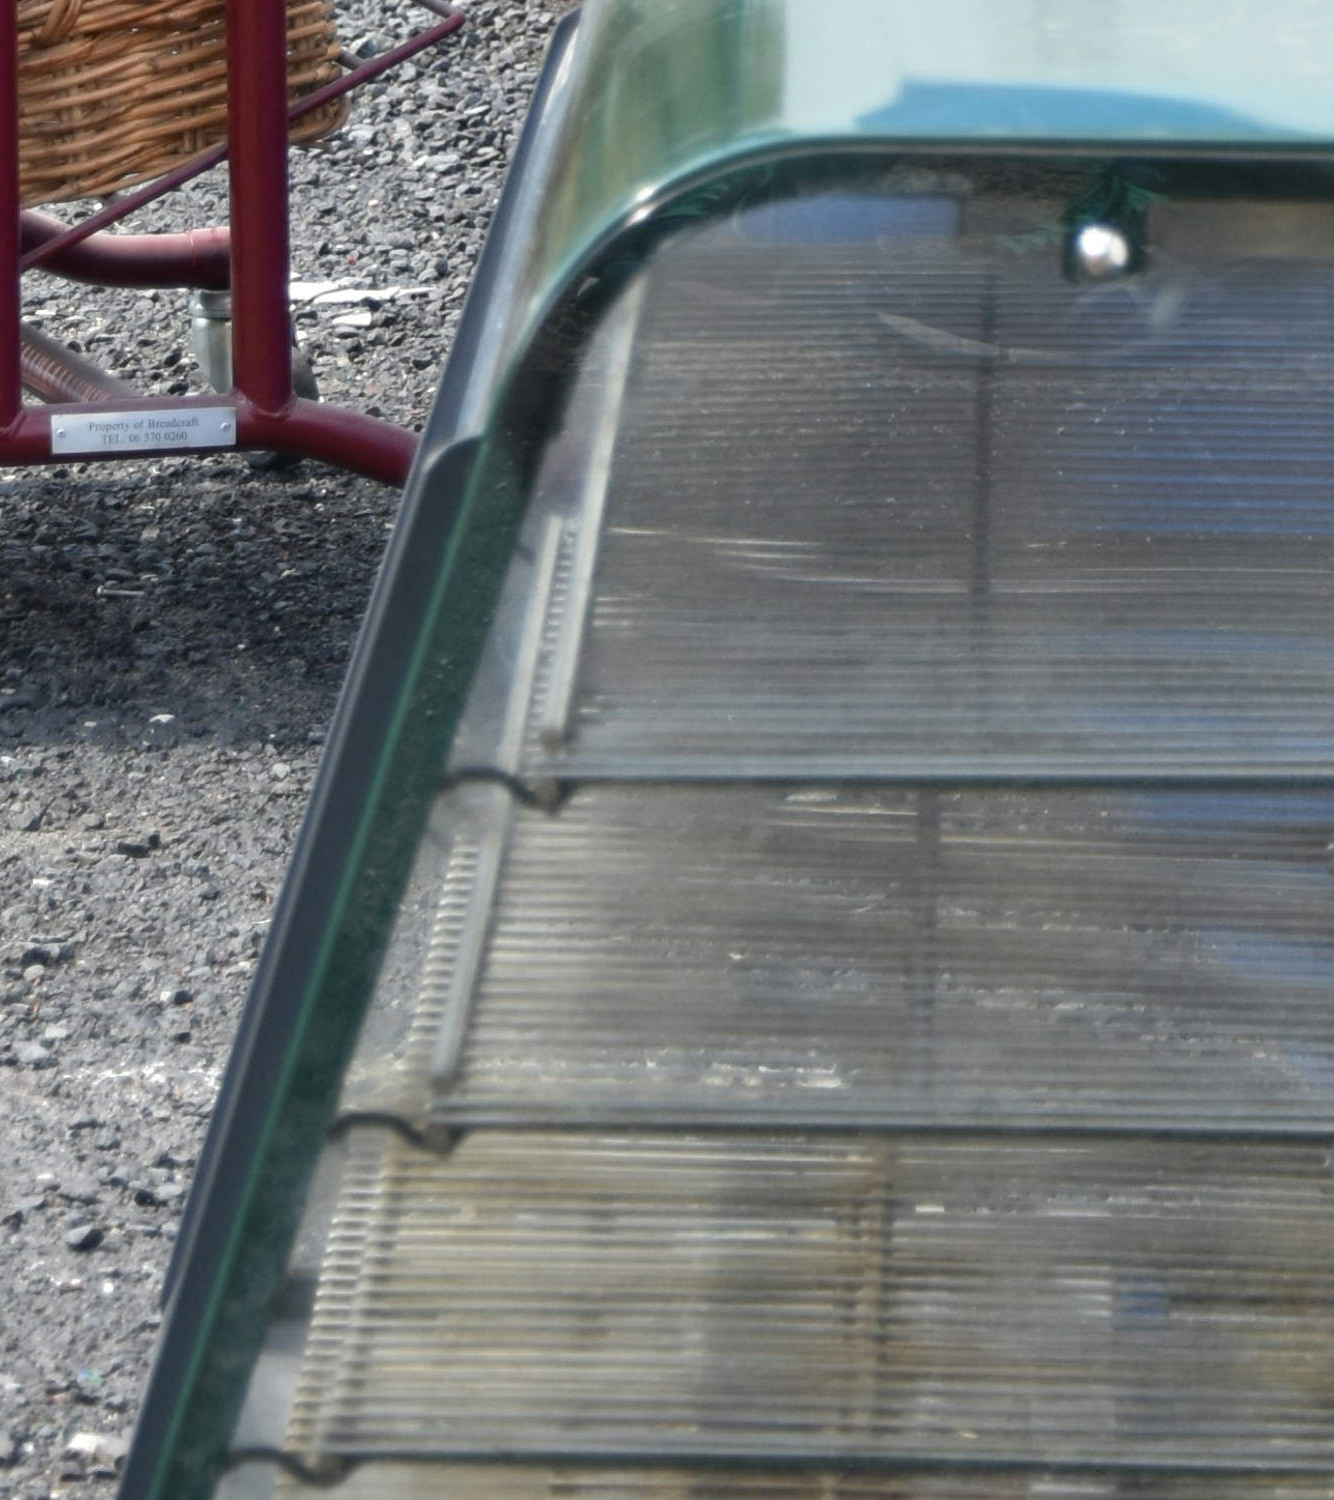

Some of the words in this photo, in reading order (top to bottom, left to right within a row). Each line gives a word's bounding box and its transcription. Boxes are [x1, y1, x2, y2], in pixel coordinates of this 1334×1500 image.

[89, 421, 129, 432] Property
[134, 419, 145, 429] of
[148, 416, 199, 429] Breadcraft
[129, 432, 141, 442] 06
[145, 431, 161, 442] 370
[164, 430, 188, 441] 0260
